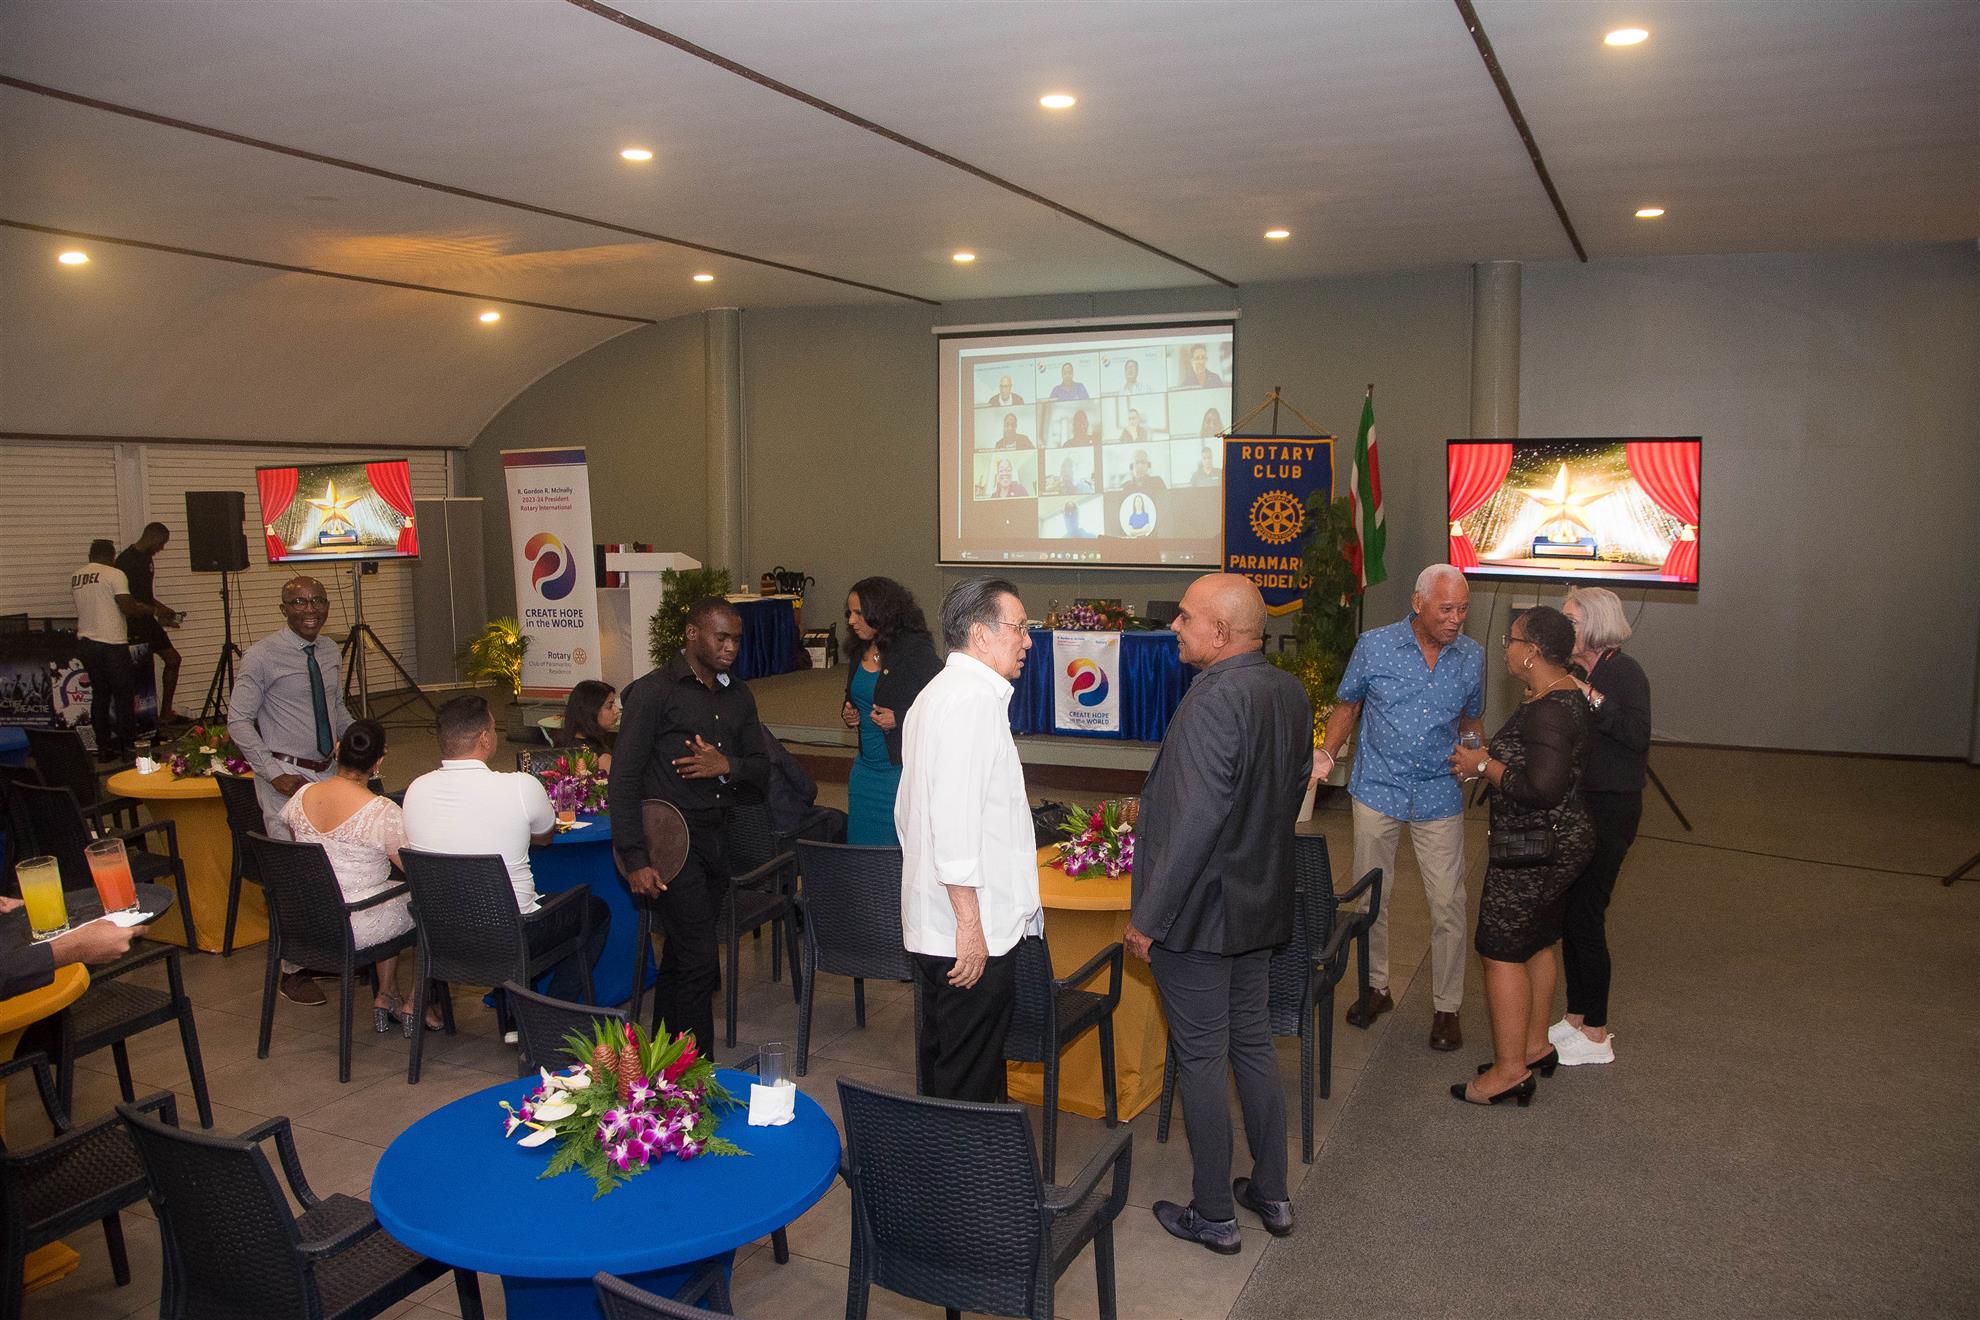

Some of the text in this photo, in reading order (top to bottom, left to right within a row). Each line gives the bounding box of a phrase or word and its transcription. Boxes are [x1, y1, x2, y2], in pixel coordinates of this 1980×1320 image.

[1241, 446, 1315, 461] ROTARY
[1254, 464, 1302, 479] CLUB
[525, 608, 583, 618] CREATE HOPE
[526, 618, 585, 628] in the WORLD
[548, 651, 571, 661] Rotary
